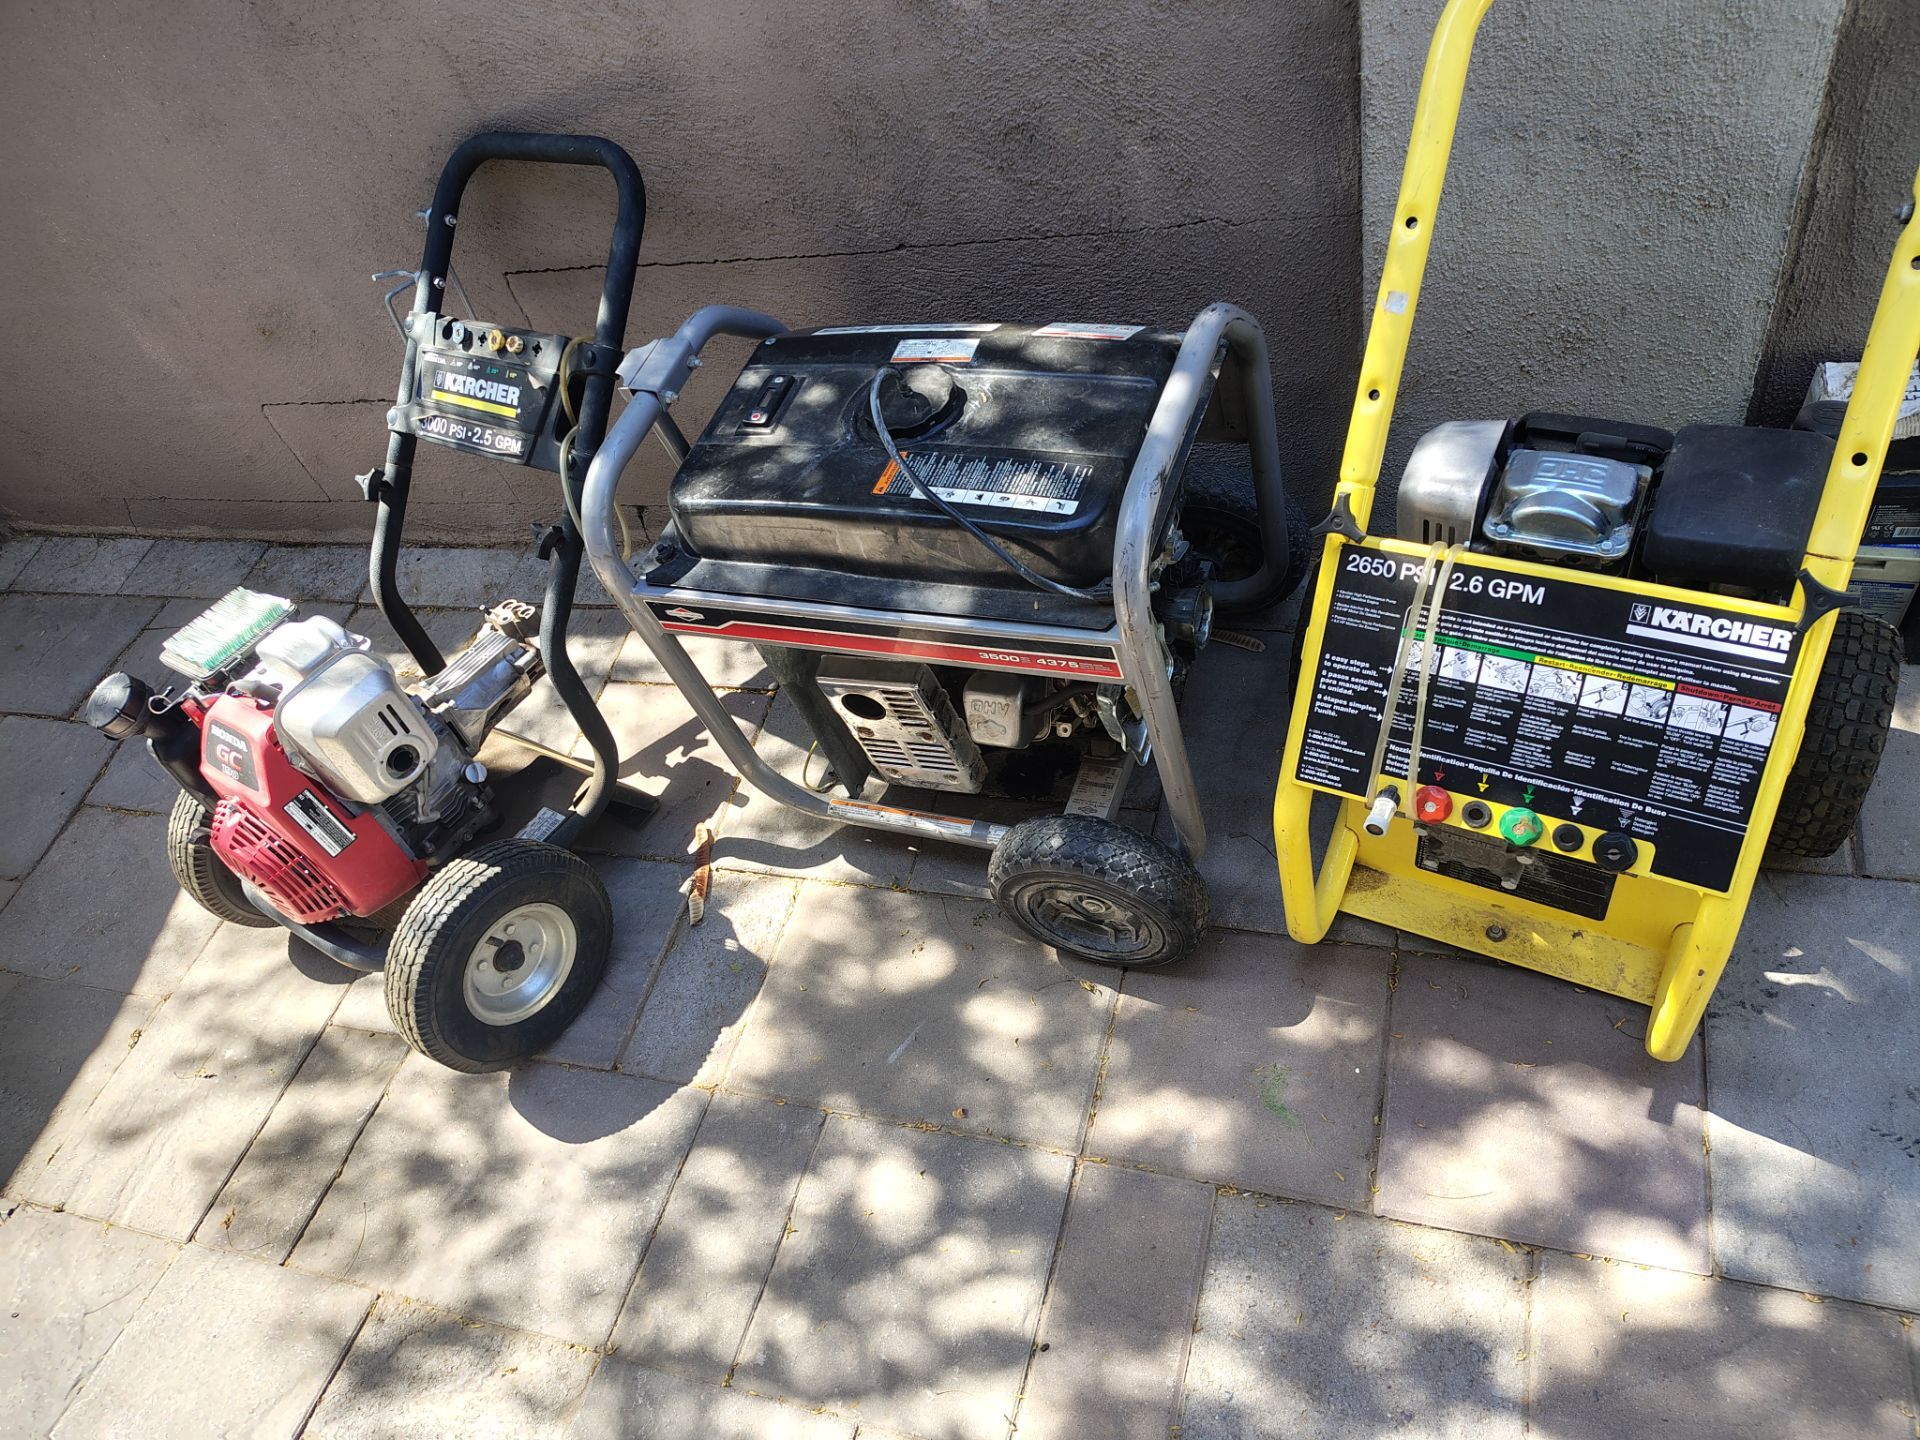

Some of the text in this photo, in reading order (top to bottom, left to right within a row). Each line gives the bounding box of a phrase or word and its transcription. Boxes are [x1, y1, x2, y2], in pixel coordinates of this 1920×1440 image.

[444, 372, 520, 406] KÄRCHER
[421, 416, 522, 456] 3000 PSI 2.5 GPM
[1346, 554, 1395, 578] 2650
[1449, 573, 1484, 594] 2.6
[1487, 578, 1545, 606] GPM
[1651, 607, 1793, 651] KÄRCHER
[979, 652, 1020, 664] 3500
[1036, 658, 1079, 669] 4375
[1331, 655, 1348, 664] easy
[1349, 658, 1369, 668] steps
[1332, 662, 1360, 673] operate
[1361, 668, 1378, 677] unit.
[1538, 657, 1565, 667] Restart
[1680, 685, 1719, 698] Shutdown
[1320, 677, 1368, 692] para manejar
[1328, 671, 1349, 681] pasos
[1350, 676, 1383, 688] sencillos
[1327, 685, 1354, 695] unidad.
[971, 699, 1010, 718] OHV
[1315, 700, 1358, 715] pour manier
[1323, 694, 1347, 706] étapes
[1348, 700, 1377, 712] simples
[211, 724, 248, 752] HONDA
[217, 743, 243, 773] GC
[1468, 763, 1500, 776] Boquilla
[1501, 770, 1513, 778] De
[1514, 773, 1570, 792] Identificación
[1573, 788, 1630, 807] Identification
[1631, 802, 1643, 810] De
[1644, 805, 1667, 816] Buse
